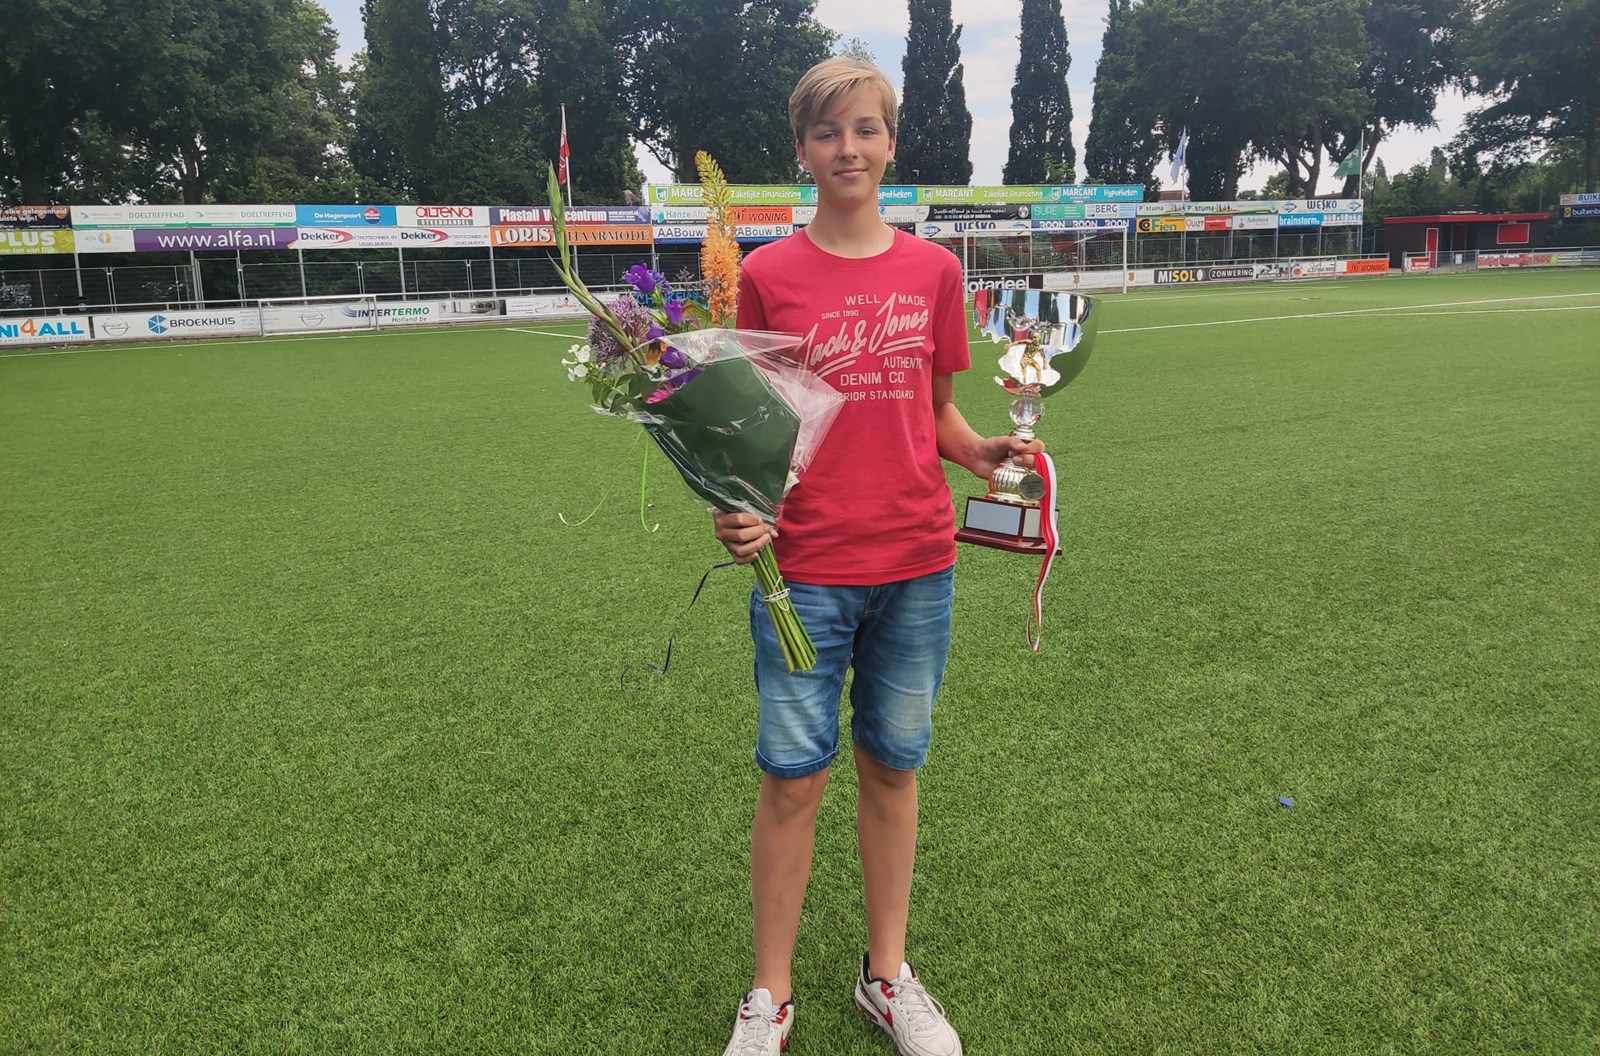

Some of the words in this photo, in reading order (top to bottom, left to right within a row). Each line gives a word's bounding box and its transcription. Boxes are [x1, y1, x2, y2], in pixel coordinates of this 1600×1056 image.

[671, 188, 706, 198] MARCA
[878, 189, 912, 199] ypotheken
[935, 189, 975, 198] MARCANT
[1062, 187, 1098, 197] MARCANT
[1095, 204, 1118, 213] BERG
[1306, 200, 1338, 210] WESKO
[499, 208, 540, 222] Plastall
[665, 211, 691, 219] Hanze
[748, 212, 787, 222] WONING
[736, 226, 773, 236] ABouw
[775, 225, 790, 236] BV
[954, 221, 996, 233] WESKO
[157, 229, 276, 248] www.alfa.nl
[300, 232, 340, 241] Dekker
[401, 231, 438, 240] Dekker
[568, 230, 649, 242] HAARMODE
[1211, 268, 1254, 279] ZONWERING
[968, 275, 1030, 293] otarieel
[844, 294, 881, 306] WELL
[898, 294, 926, 307] MADE
[357, 307, 429, 318] INTERTERMO
[821, 311, 841, 320] SINCE
[842, 309, 859, 317] 1990
[169, 316, 236, 328] BROEKHUIS
[795, 321, 851, 372] Jack
[851, 319, 867, 353] &
[868, 291, 929, 354] Jones
[840, 372, 882, 387] DENIM
[888, 371, 907, 384] CO.
[869, 390, 914, 400] STANDARD
